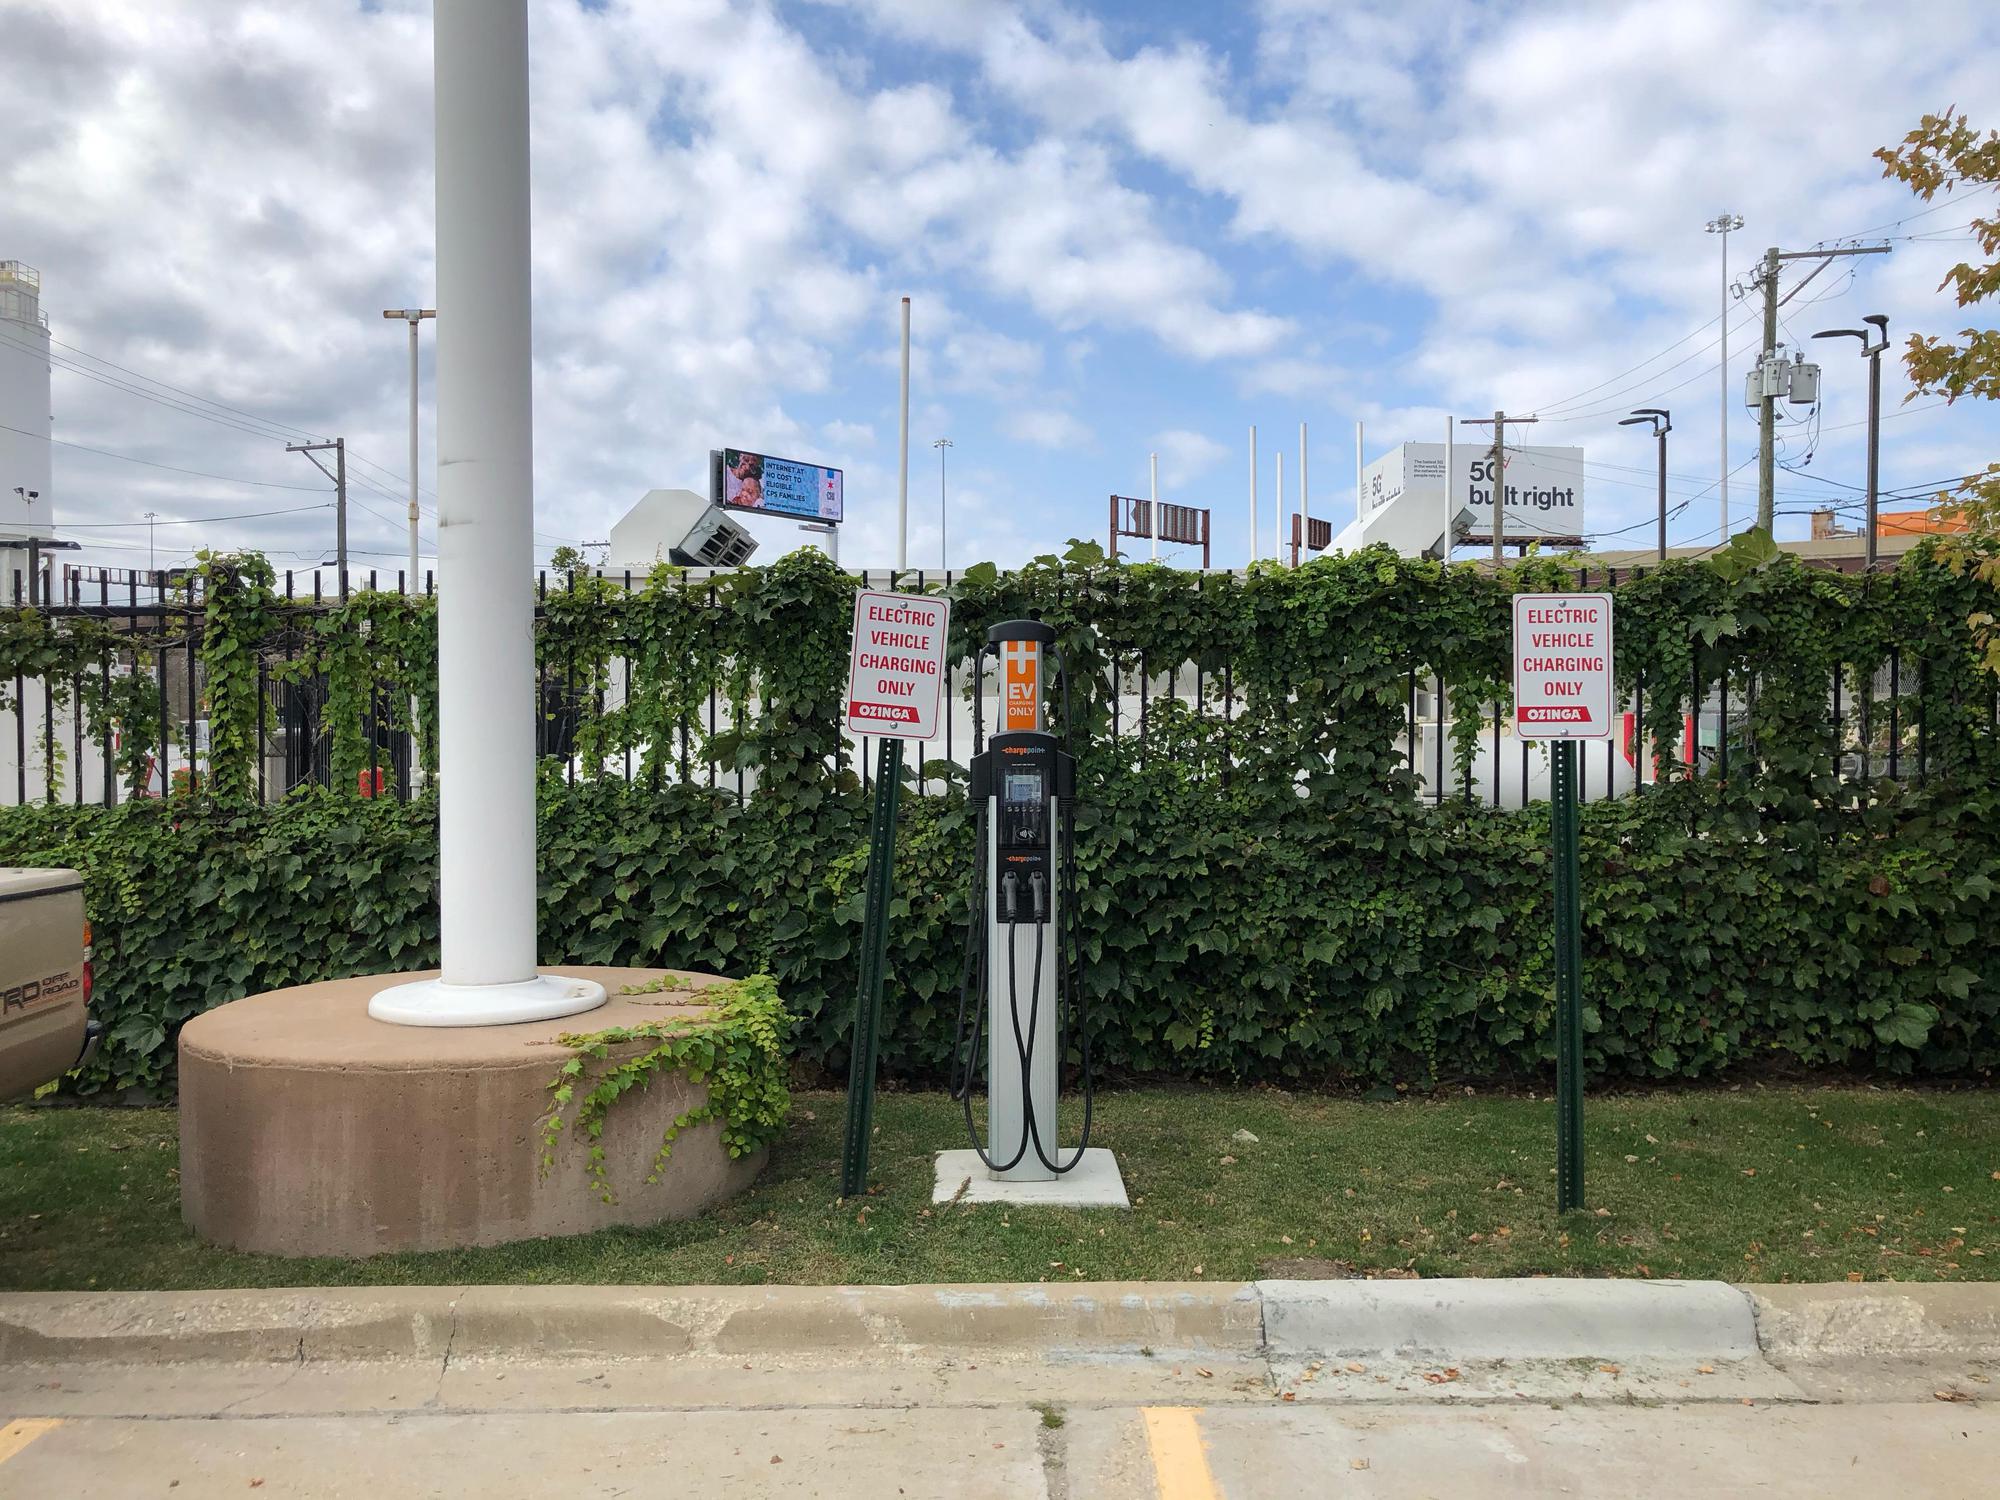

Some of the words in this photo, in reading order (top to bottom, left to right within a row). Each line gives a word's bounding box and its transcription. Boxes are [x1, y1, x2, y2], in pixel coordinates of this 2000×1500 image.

[766, 462, 795, 473] INTERNET
[766, 471, 775, 479] NO
[777, 473, 792, 481] COST
[793, 475, 802, 483] TO
[766, 480, 792, 490] ELIGIBLE
[1372, 473, 1382, 497] 5G
[766, 489, 777, 497] CPS
[1469, 484, 1518, 505] bult
[1522, 486, 1574, 510] right
[869, 606, 936, 627] ELECTRIC
[1528, 609, 1598, 624] ELECTRIC
[871, 630, 930, 650] VEHICLE
[1532, 633, 1594, 648] VEHICLE
[859, 653, 936, 675] CHARGING
[1523, 657, 1604, 672] CHARGING
[877, 679, 916, 697] ONLY
[1009, 683, 1035, 700] EV
[1544, 681, 1584, 696] ONLY
[859, 704, 910, 720] OZINGA
[1009, 707, 1035, 716] ONLY
[1527, 708, 1581, 720] OZINGA
[42, 971, 70, 986] OFF
[42, 979, 79, 996] ROAD
